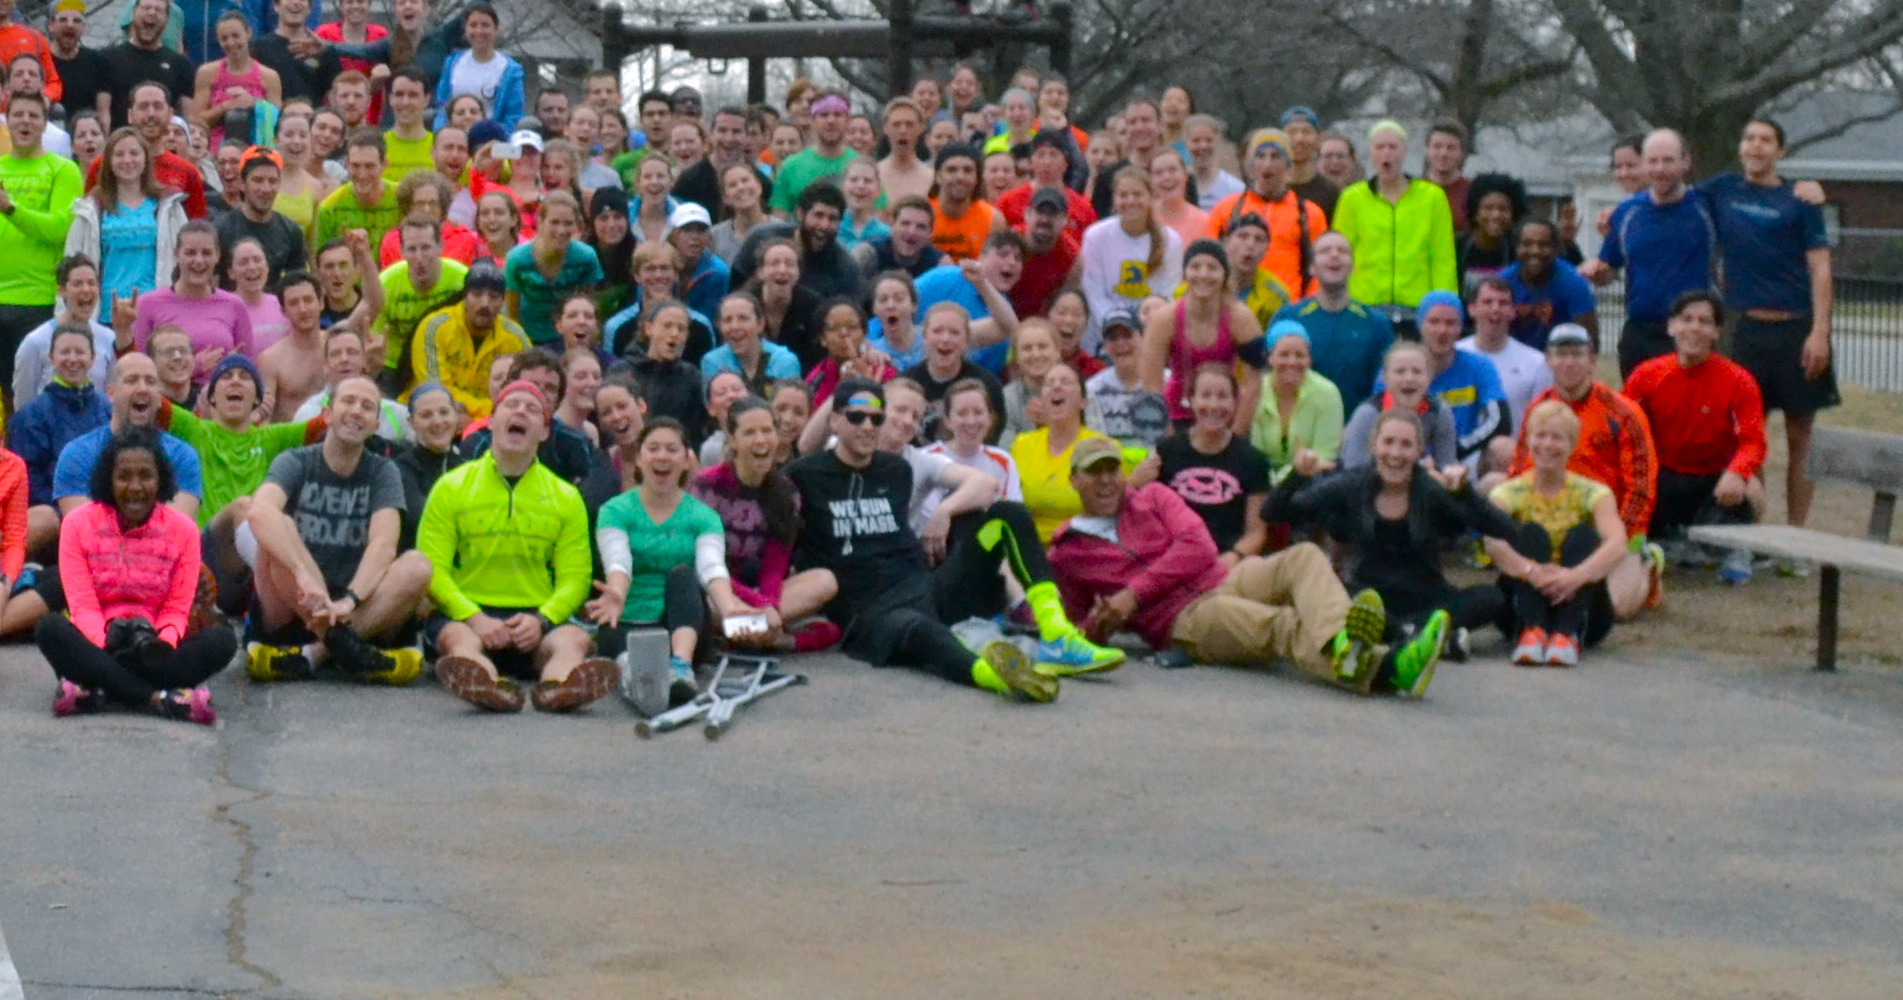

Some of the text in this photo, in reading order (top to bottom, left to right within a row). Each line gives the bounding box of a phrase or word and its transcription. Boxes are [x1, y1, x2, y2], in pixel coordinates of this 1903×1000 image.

[828, 497, 893, 518] WE RUN
[833, 518, 853, 537] IN
